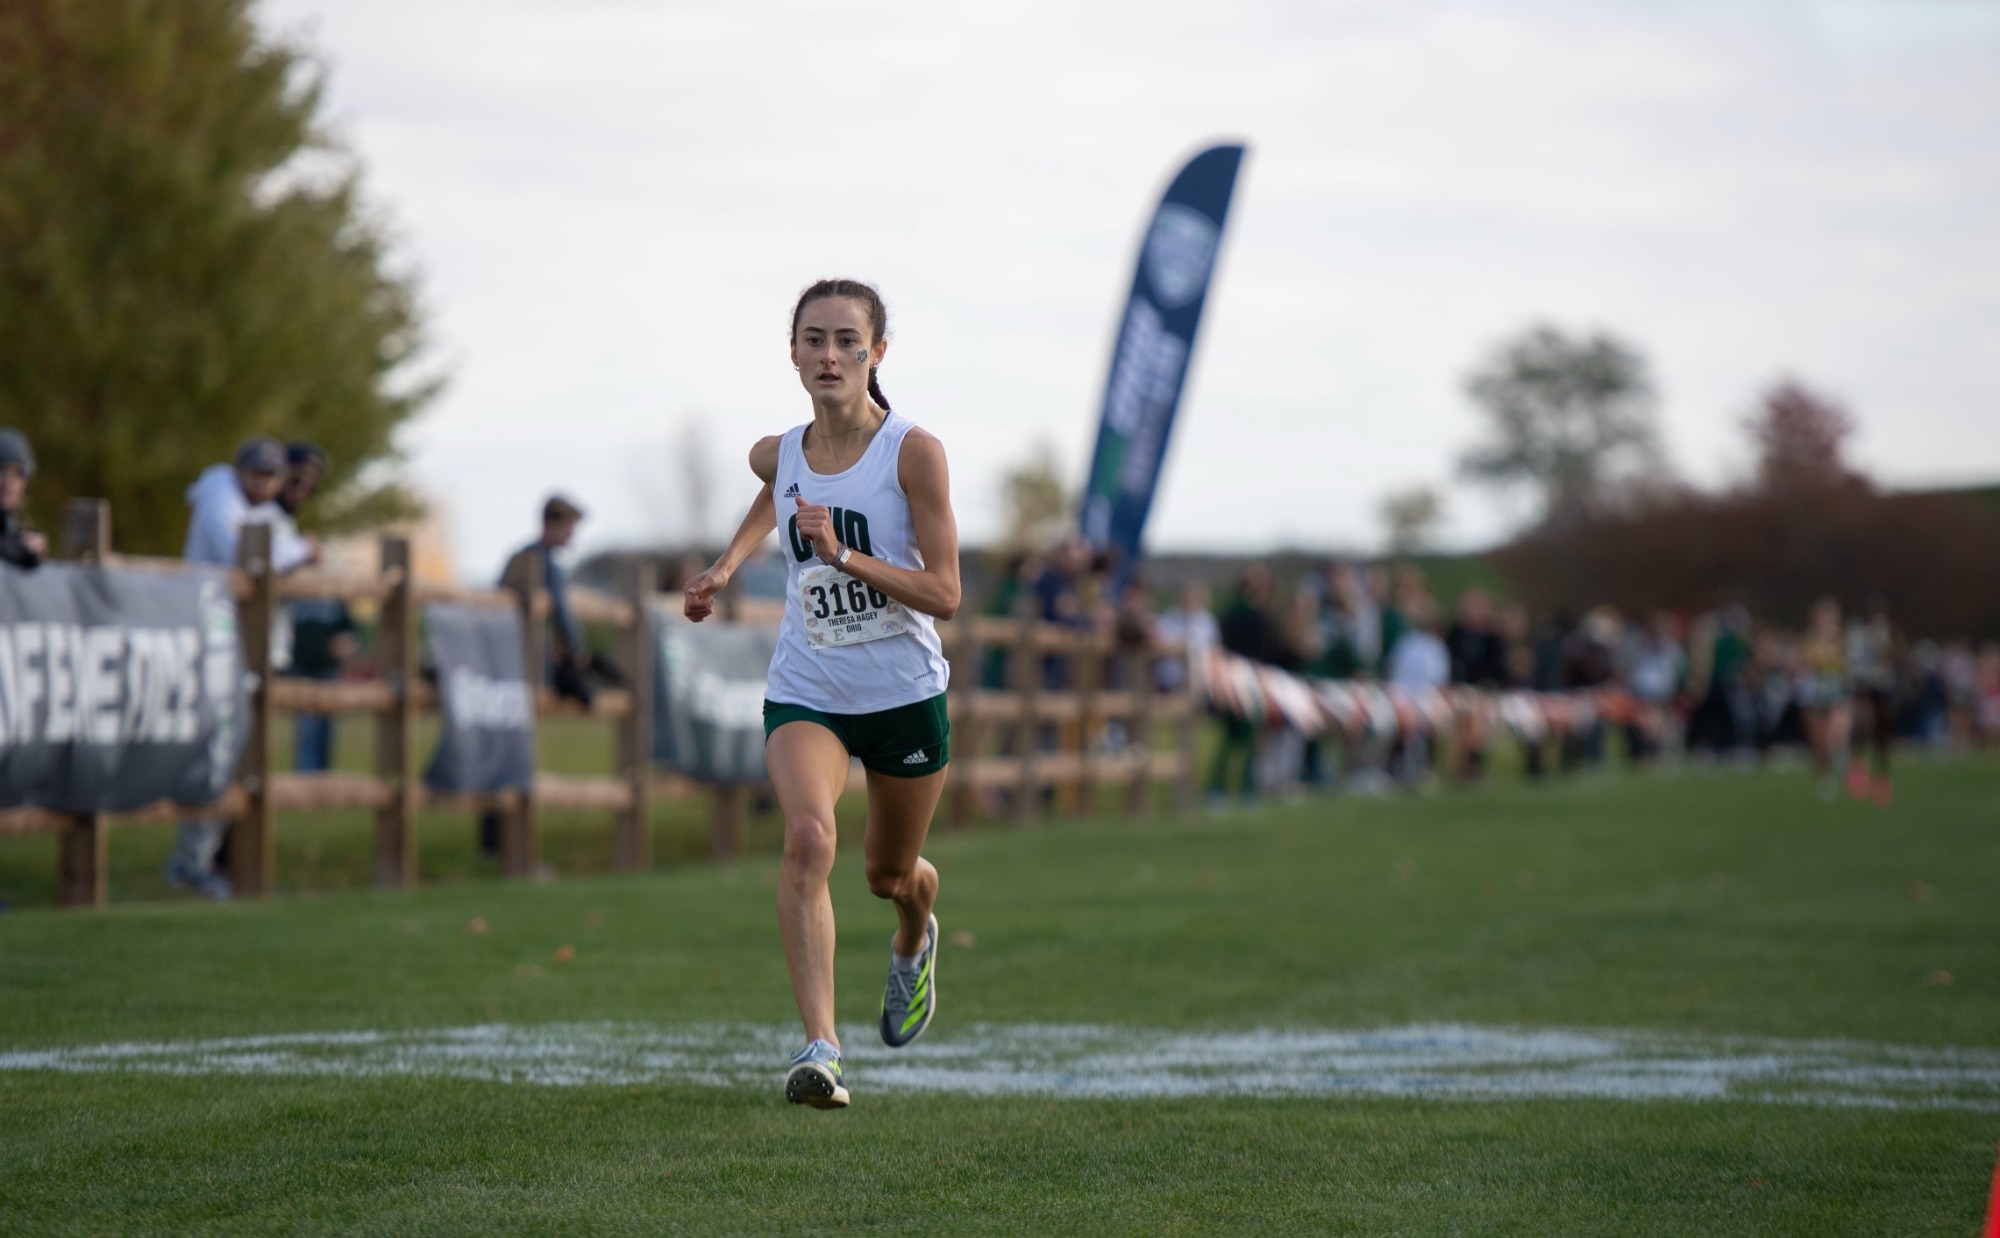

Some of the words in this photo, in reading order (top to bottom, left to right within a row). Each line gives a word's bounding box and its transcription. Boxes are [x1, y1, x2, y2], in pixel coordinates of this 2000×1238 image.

[789, 506, 873, 562] OIO
[810, 580, 888, 619] 3166
[827, 616, 856, 627] THERESA
[856, 611, 878, 622] HAGEY
[846, 623, 862, 633] OHIO
